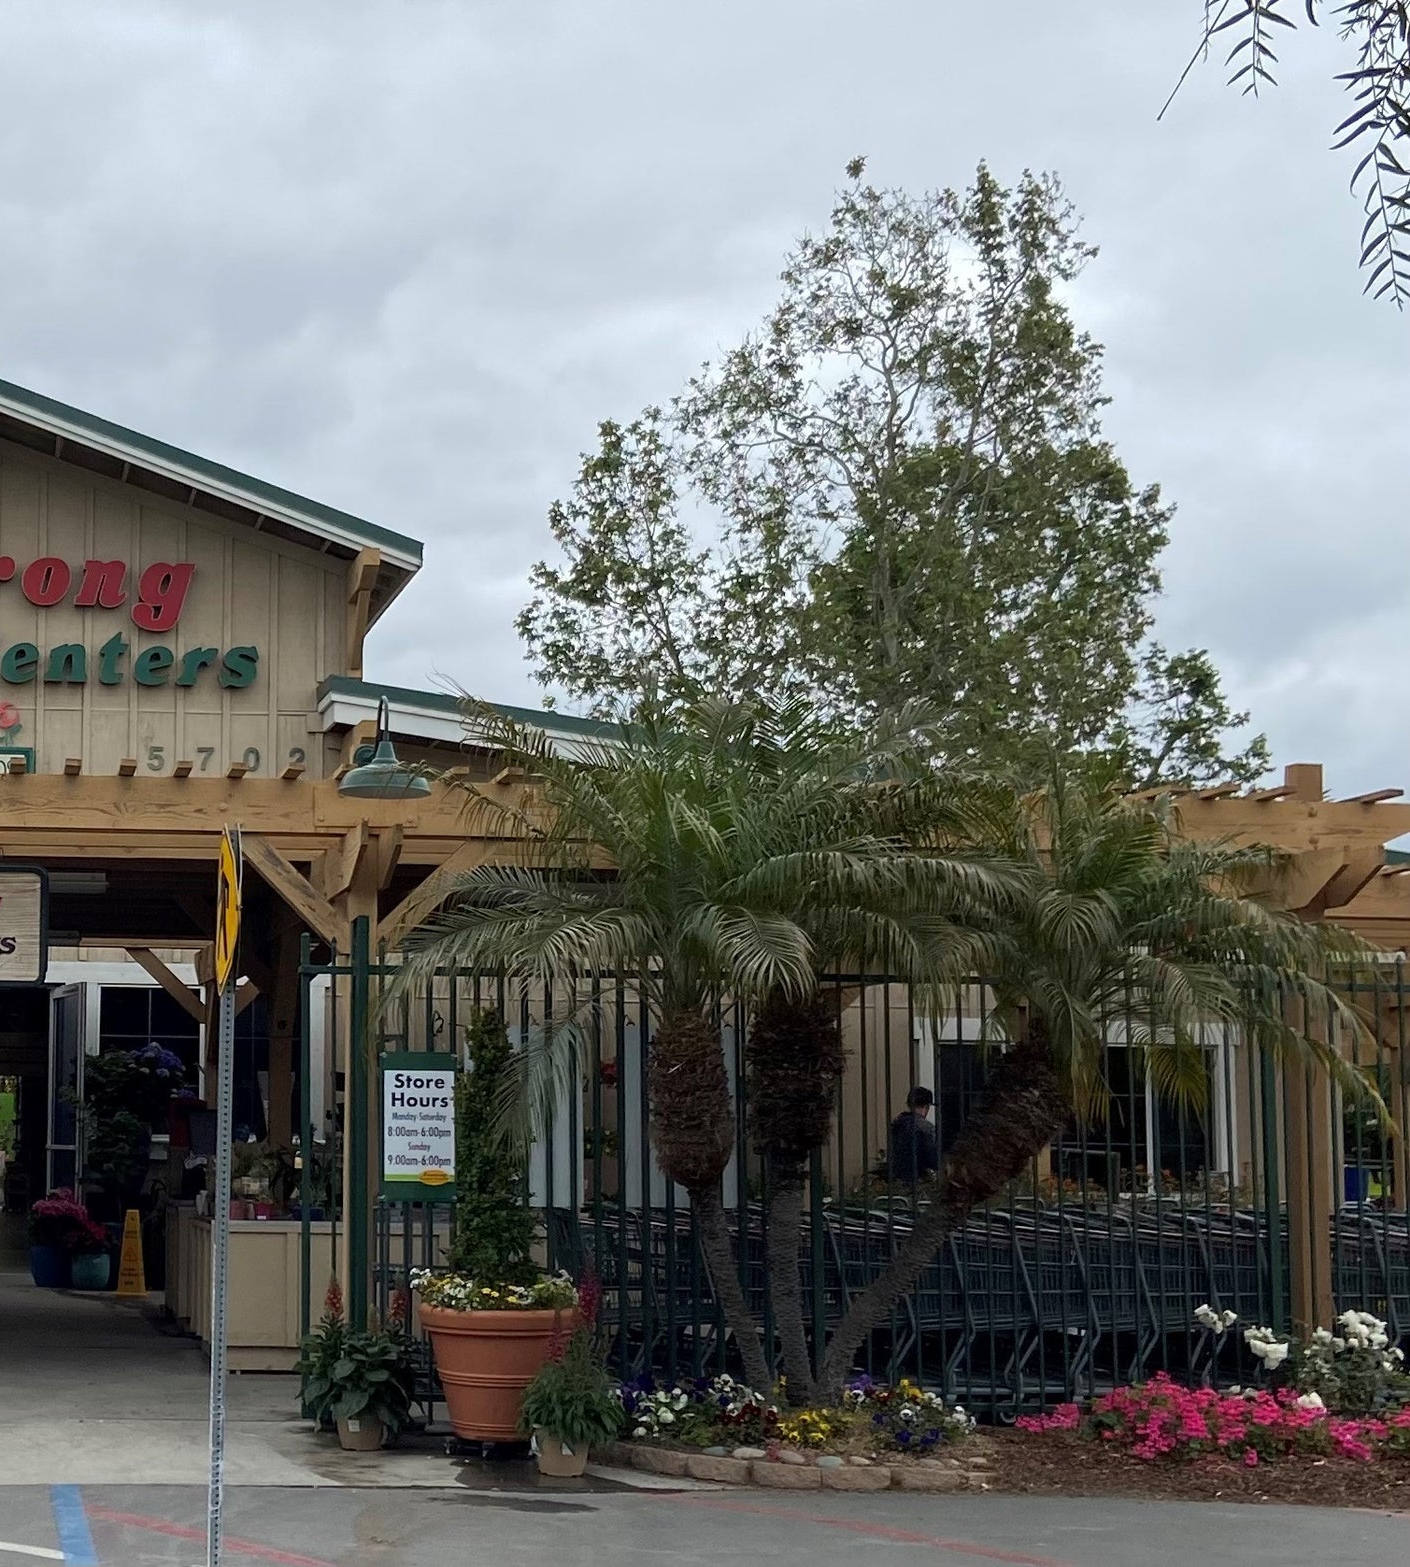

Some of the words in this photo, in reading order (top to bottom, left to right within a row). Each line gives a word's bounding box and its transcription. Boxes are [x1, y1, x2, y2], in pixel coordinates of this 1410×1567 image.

[394, 1073, 446, 1089] Store
[391, 1092, 449, 1108] Hours
[408, 1142, 431, 1152] Sunday
